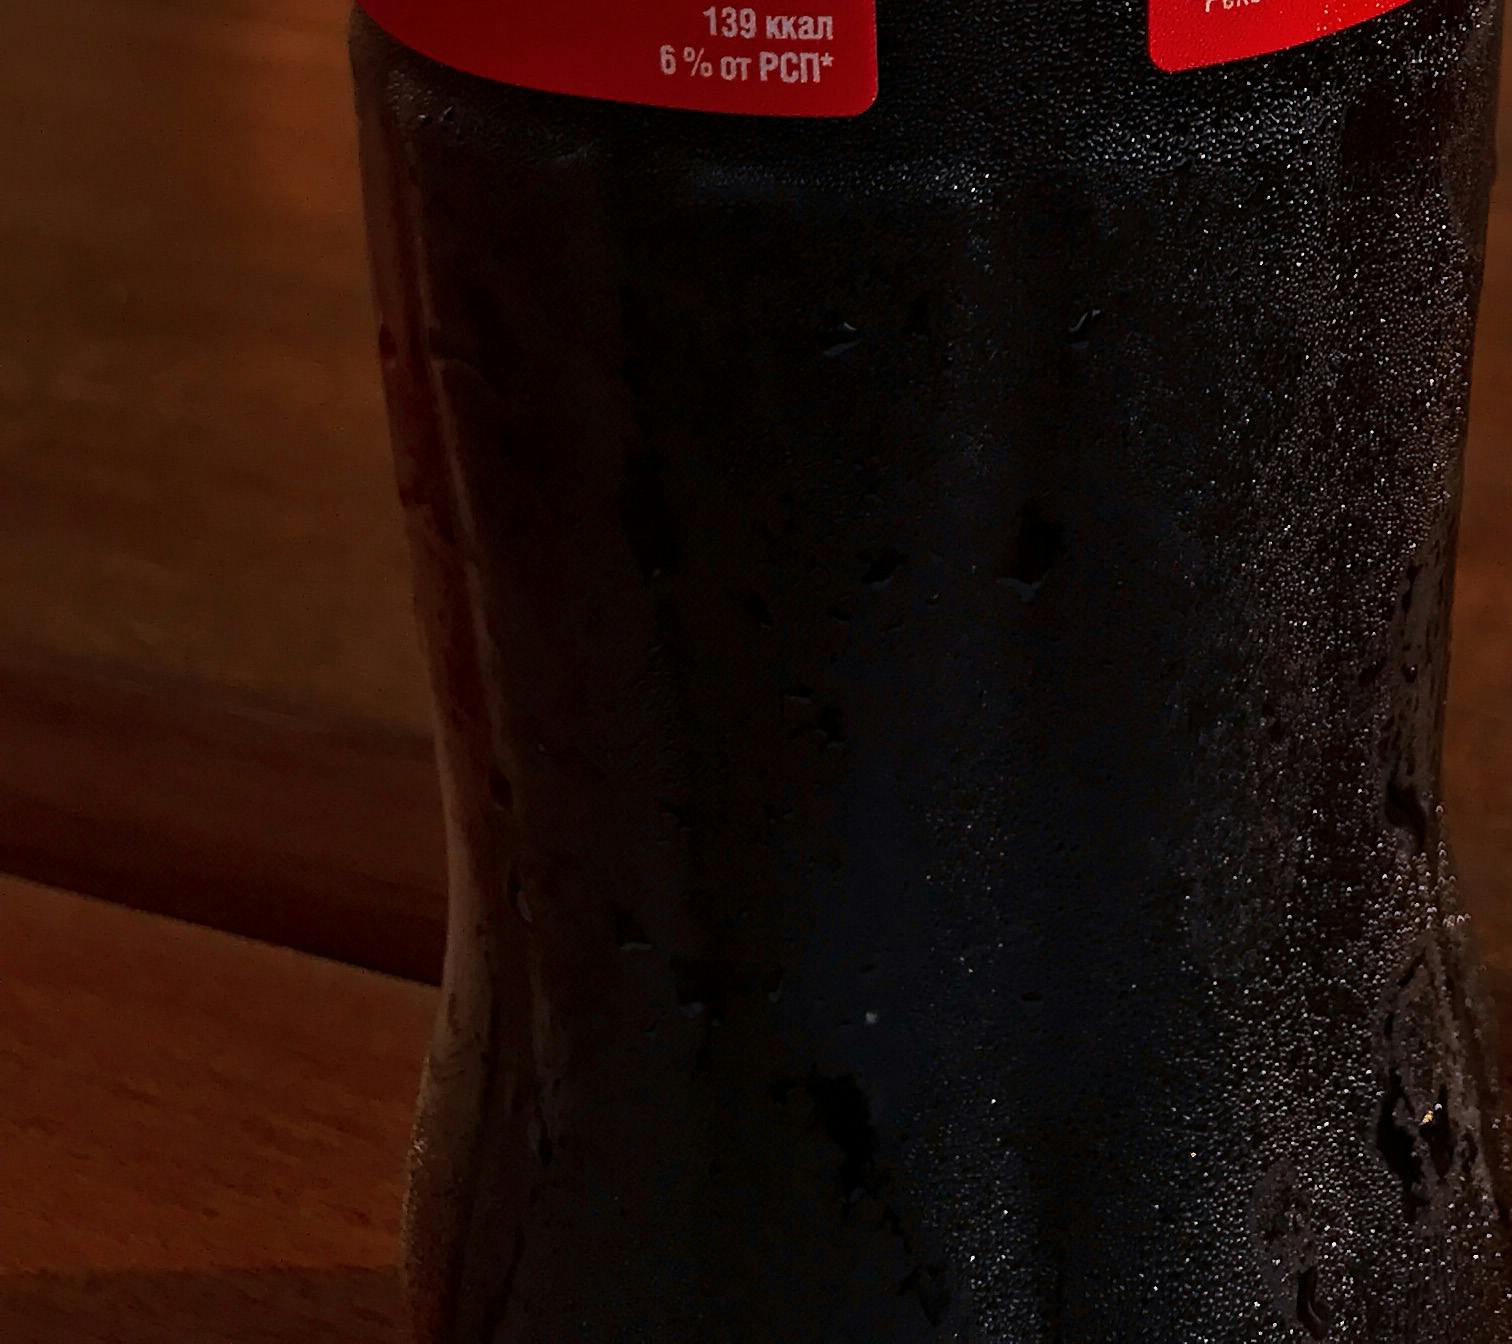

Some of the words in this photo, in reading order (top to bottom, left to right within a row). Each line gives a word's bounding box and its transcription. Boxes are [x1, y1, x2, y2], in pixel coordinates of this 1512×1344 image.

[703, 6, 756, 39] 139
[766, 15, 834, 40] ккал
[720, 56, 752, 81] от
